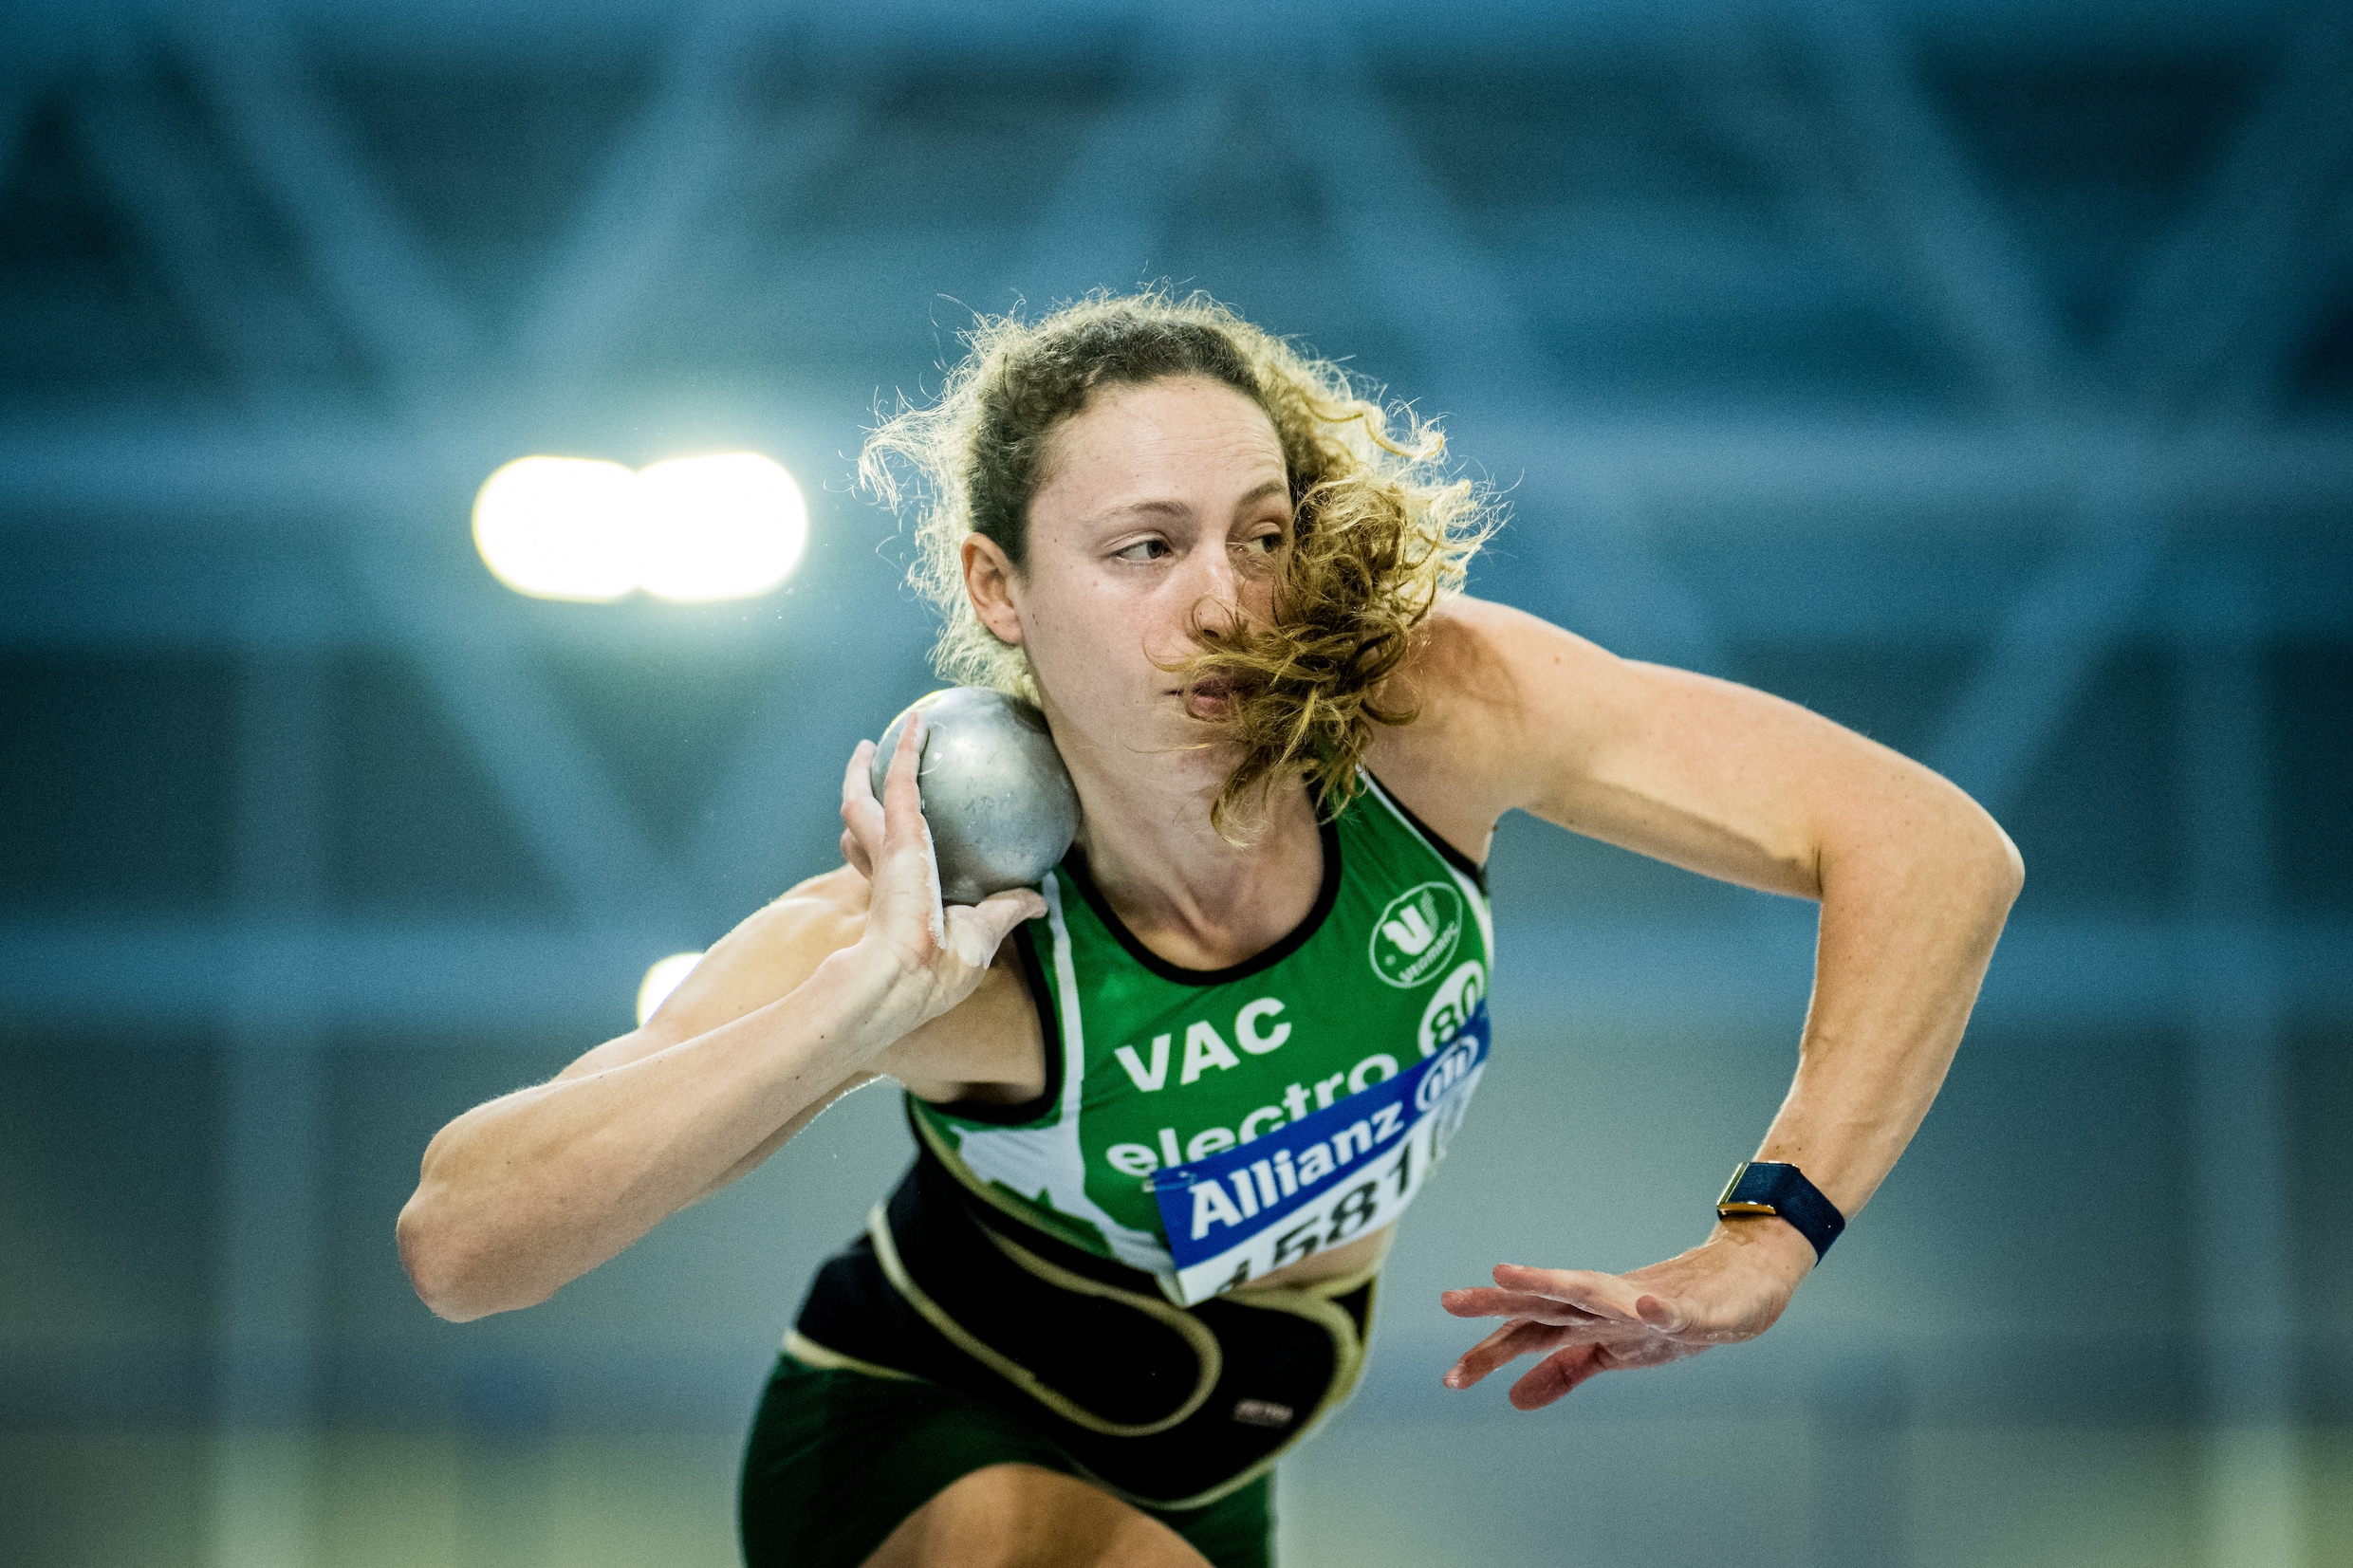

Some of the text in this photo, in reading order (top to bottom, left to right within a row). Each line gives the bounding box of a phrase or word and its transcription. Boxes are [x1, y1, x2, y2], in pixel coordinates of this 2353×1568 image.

[1115, 997, 1291, 1093] VAC
[1105, 1053, 1399, 1178] electro
[1190, 1100, 1405, 1241] Allianz
